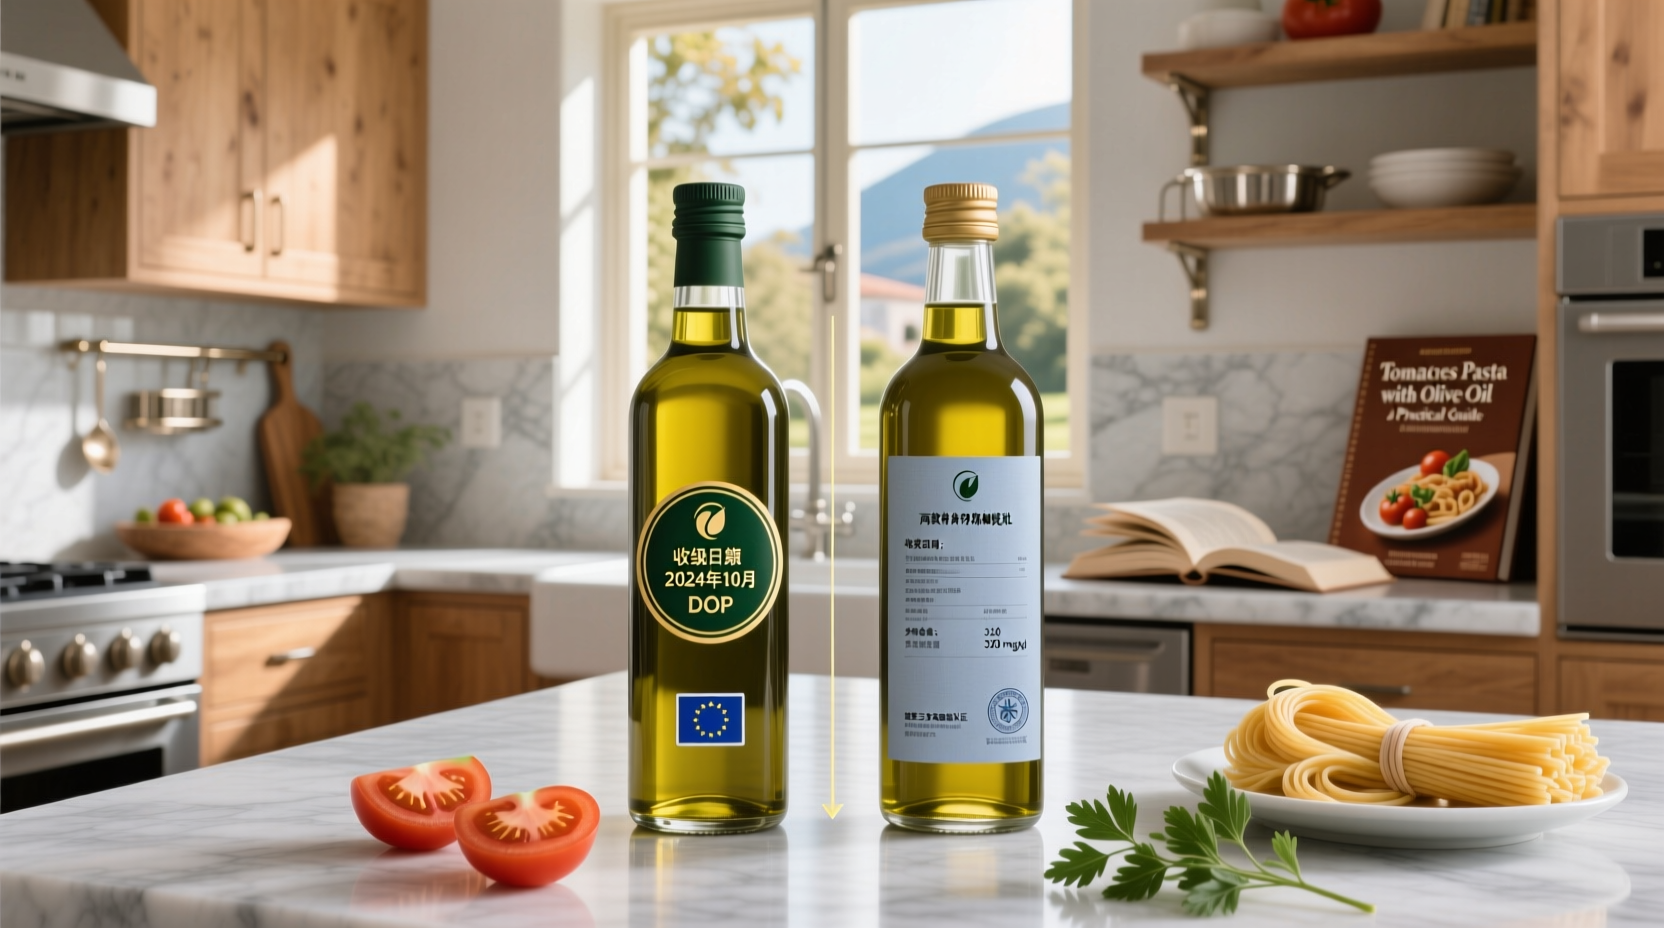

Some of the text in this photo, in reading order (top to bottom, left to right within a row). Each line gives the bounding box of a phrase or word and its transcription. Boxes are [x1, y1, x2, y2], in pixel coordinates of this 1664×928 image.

[1461, 361, 1507, 381] Pasta
[1381, 383, 1493, 404] with Olive Oil
[664, 570, 755, 589] 2024年10月
[688, 595, 734, 614] DOP
